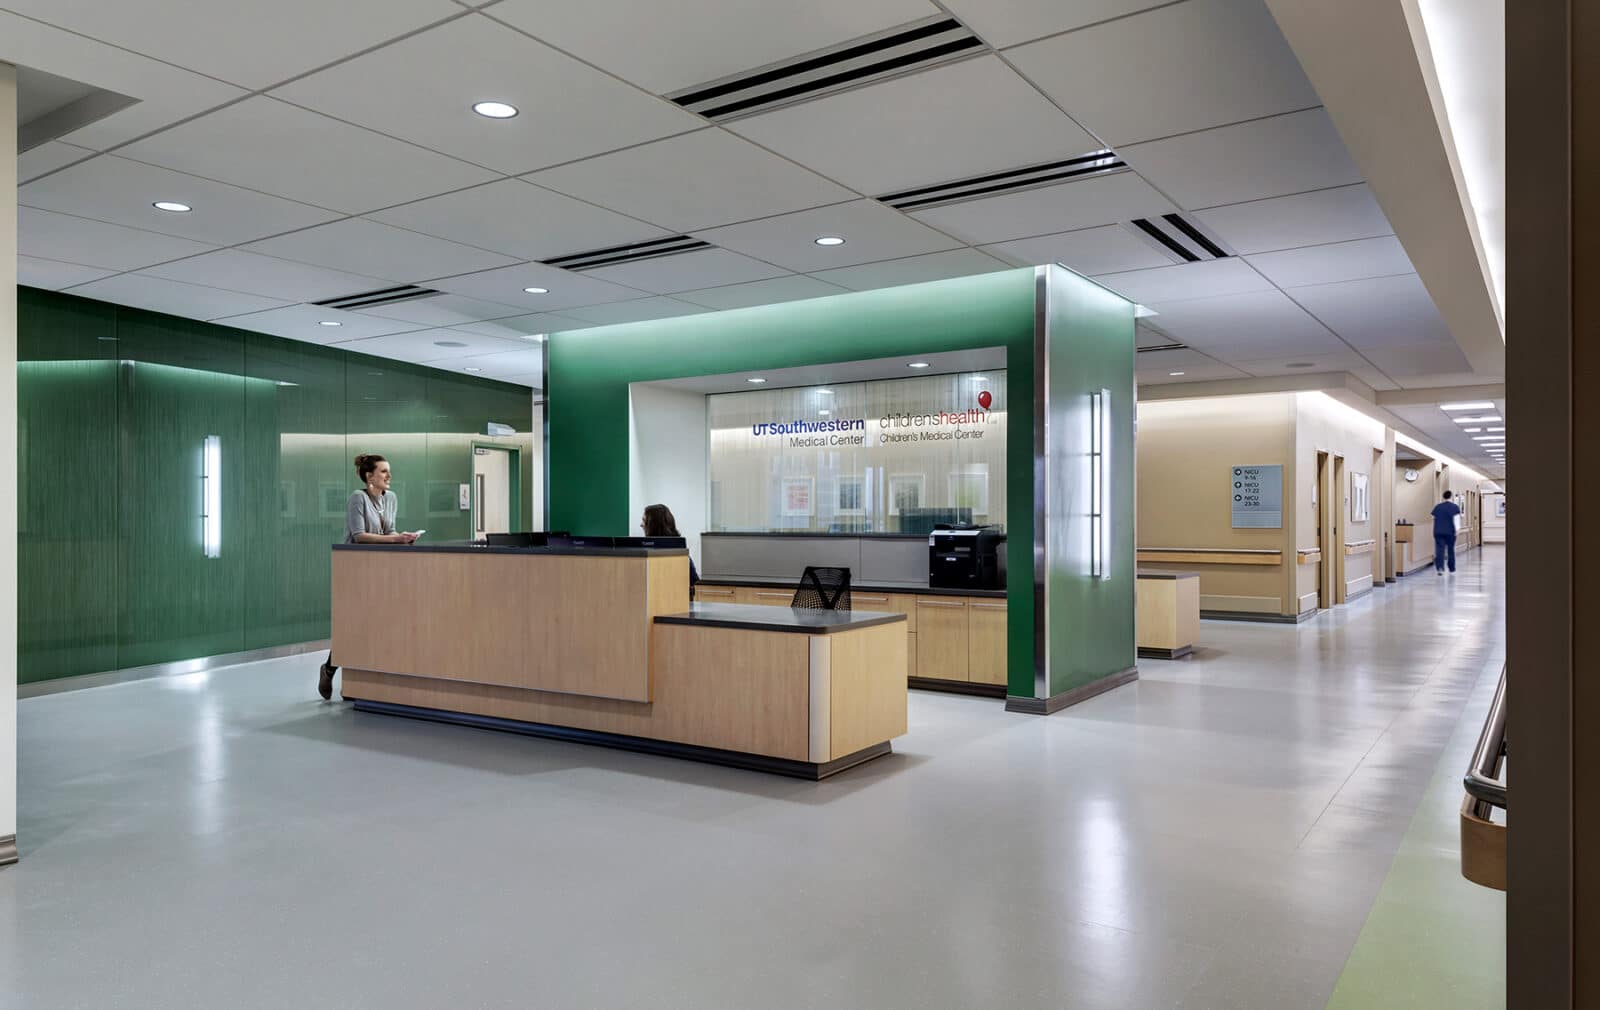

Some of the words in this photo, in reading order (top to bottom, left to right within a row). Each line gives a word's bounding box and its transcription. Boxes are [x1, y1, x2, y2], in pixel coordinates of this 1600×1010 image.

[879, 408, 985, 428] childrenshealth
[789, 436, 828, 448] Medical
[829, 434, 865, 446] Center
[879, 431, 918, 443] Children's
[920, 431, 953, 441] Medical
[954, 430, 985, 440] Center
